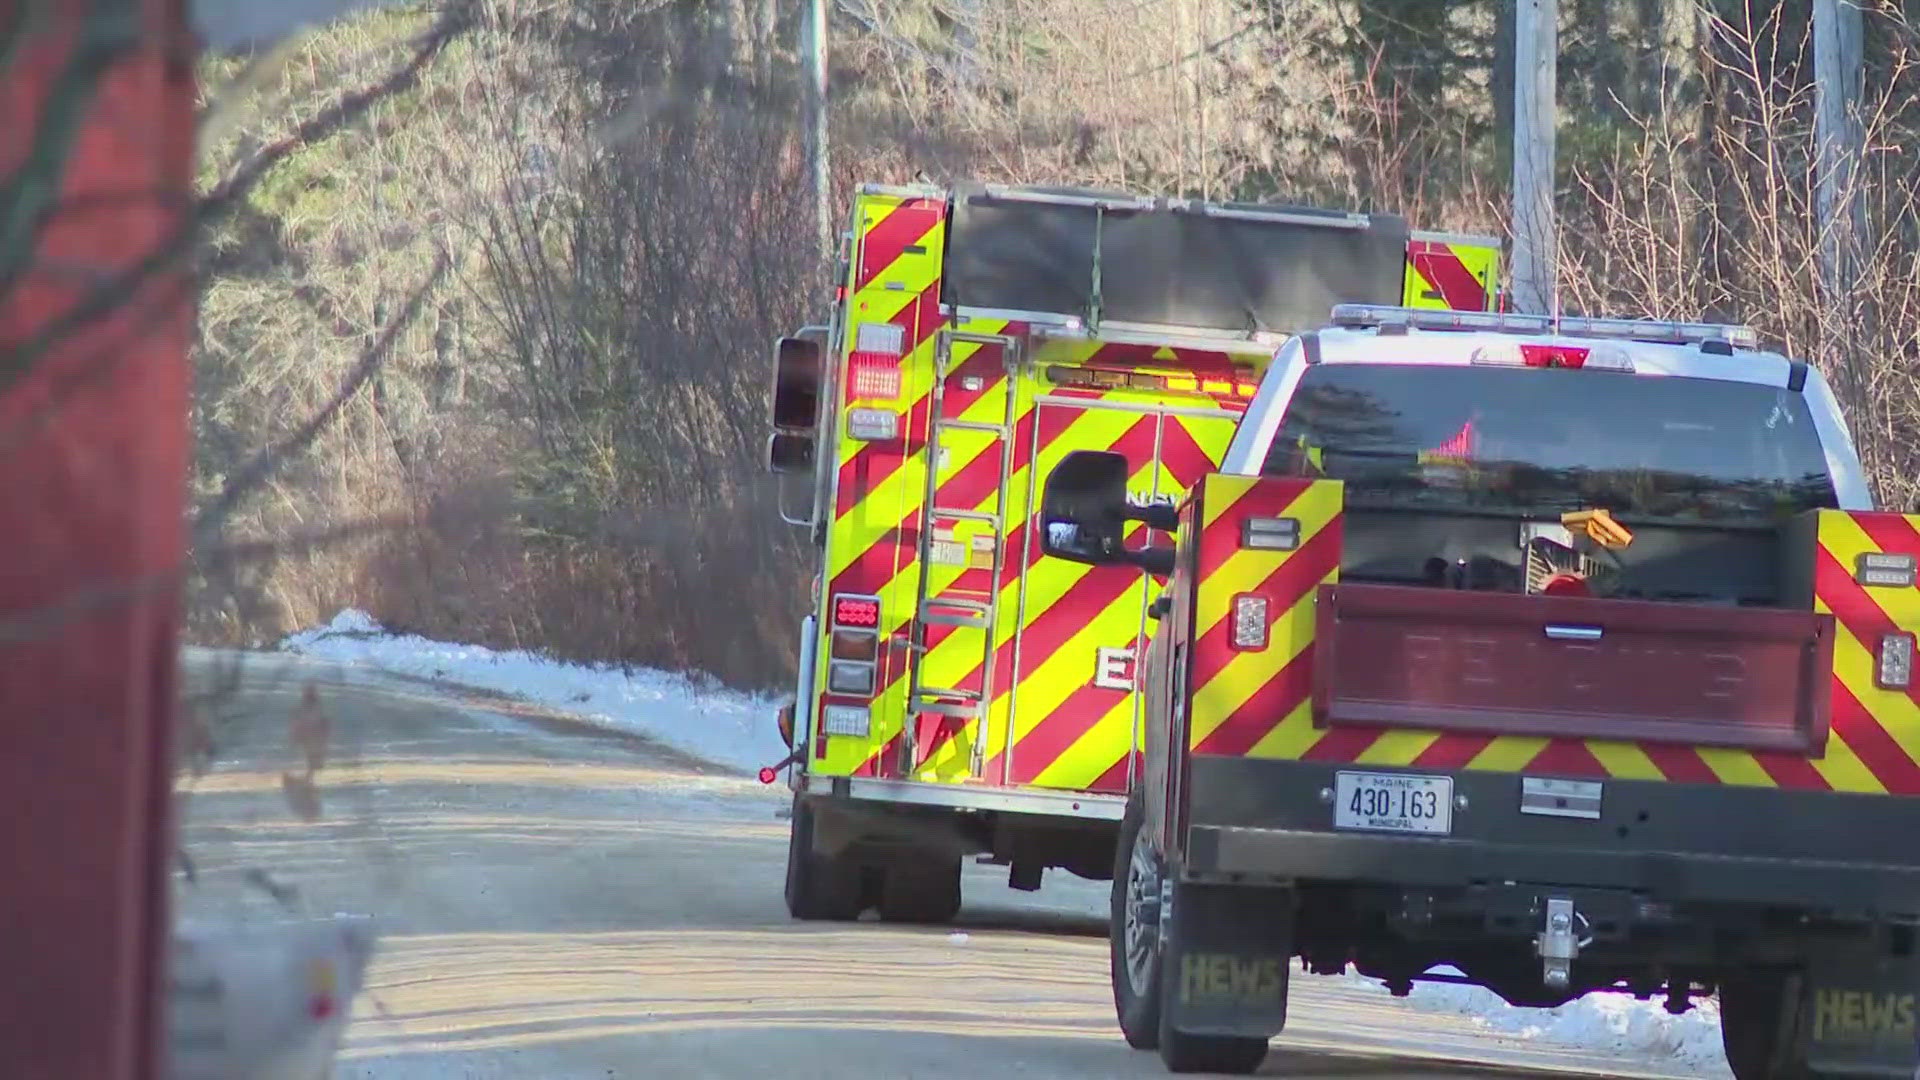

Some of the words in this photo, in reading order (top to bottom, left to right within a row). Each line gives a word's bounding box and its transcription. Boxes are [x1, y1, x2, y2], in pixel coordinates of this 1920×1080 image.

[1373, 777, 1413, 788] MAINE
[1368, 818, 1414, 829] MUNICIPAL
[1181, 952, 1281, 1004] HEWS
[1814, 988, 1915, 1041] HEWS
